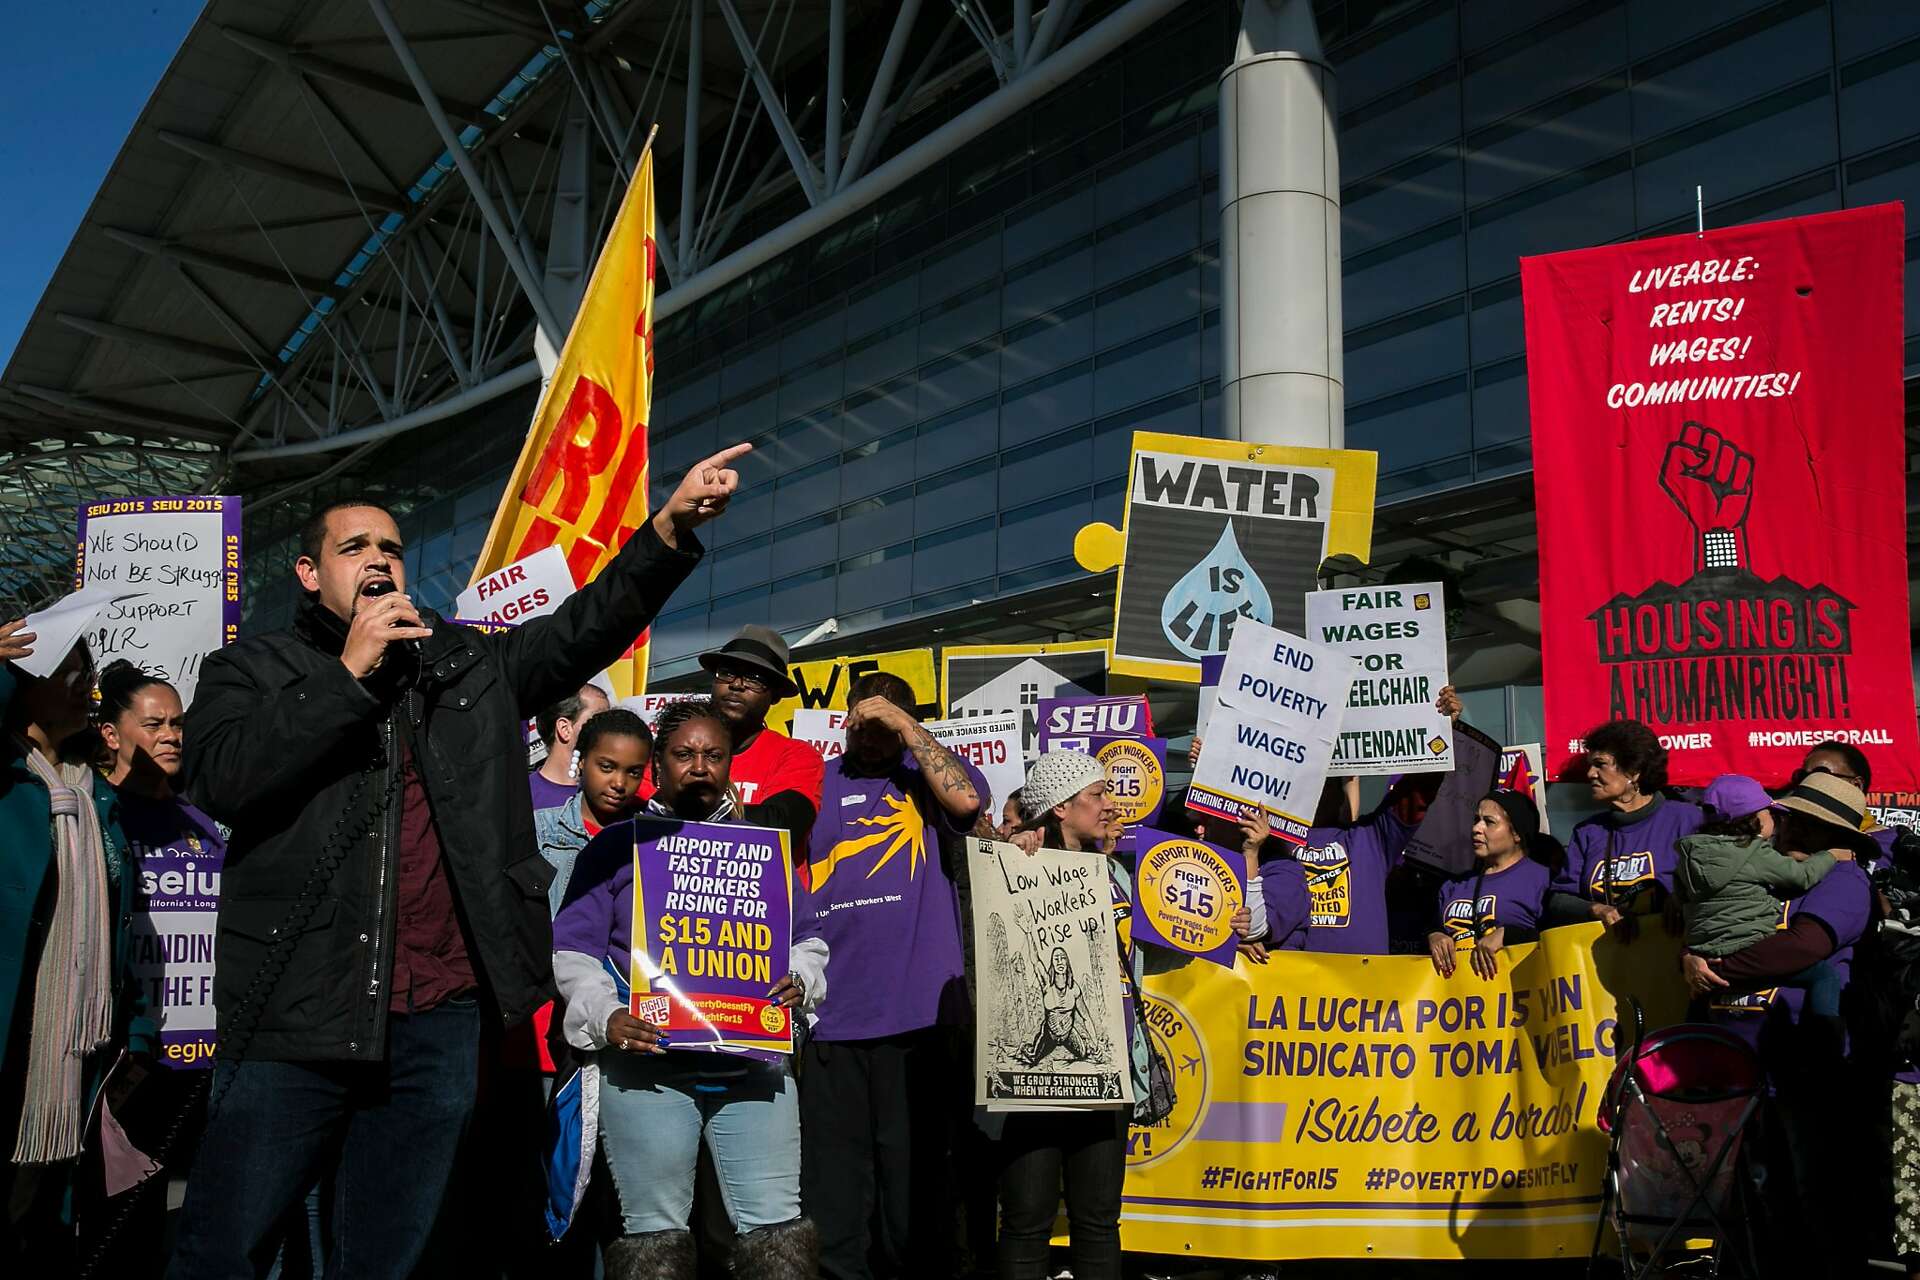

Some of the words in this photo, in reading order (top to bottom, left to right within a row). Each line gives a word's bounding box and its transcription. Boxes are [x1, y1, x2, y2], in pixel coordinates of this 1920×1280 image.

[1629, 256, 1760, 293] LIVEABLE:
[1649, 298, 1745, 328] RENTS!
[1649, 336, 1752, 367] WAGES!
[1606, 371, 1802, 409] COMMUNITIES!
[1140, 456, 1320, 519] WATER
[87, 503, 110, 517] SEIU
[113, 502, 145, 513] 2015
[152, 500, 183, 511] SEIU
[187, 500, 223, 511] 2015
[88, 529, 114, 554] WE
[227, 535, 239, 570] 2015
[128, 562, 152, 583] BE
[476, 564, 528, 602] FAIR
[1209, 566, 1244, 594] IS
[227, 571, 239, 602] SEIU
[1342, 590, 1403, 611] FAIR
[1322, 620, 1420, 643] WAGES
[1604, 600, 1797, 657] HOUSING
[1806, 599, 1843, 649] IS
[1273, 643, 1314, 673] END
[1238, 673, 1327, 720] POVERTY
[1345, 675, 1431, 708] EELCHAIR
[1609, 664, 1629, 723] A
[1632, 656, 1747, 725] HUMAN
[1748, 654, 1851, 722] RIGHT!
[956, 726, 987, 737] SERVICE
[989, 722, 1016, 733] UNITED
[1049, 704, 1138, 733] SEIU
[1237, 723, 1307, 764] WAGES
[1332, 727, 1428, 760] ATTENDANT
[1748, 729, 1894, 748] #HOMESFORALL
[947, 739, 1007, 766] CLEA
[1101, 745, 1122, 766] RPORT
[1124, 745, 1157, 774] WORKERS
[1112, 766, 1137, 774] FIGHT
[1230, 765, 1291, 800] NOW!
[1106, 778, 1141, 797] $15
[1119, 808, 1137, 818] LY!
[1190, 789, 1225, 811] FIGHTING
[1223, 799, 1239, 815] FOR
[1285, 820, 1309, 838] RIGHTS
[656, 836, 733, 859] AIRPORT
[735, 843, 773, 863] AND
[141, 862, 221, 896] seiu
[668, 855, 715, 876] FAST
[716, 859, 763, 880] FOOD
[1150, 846, 1190, 871] AIRPORT
[1192, 847, 1236, 893] WORKERS
[1175, 869, 1210, 887] FIGHT
[1308, 867, 1342, 886] JUSTICE
[673, 874, 761, 899] WORKERS
[1312, 886, 1346, 902] RKERS
[149, 899, 191, 908] lifornia's
[194, 900, 216, 909] Long
[665, 892, 728, 915] RISING
[733, 899, 768, 919] FOR
[830, 901, 854, 911] Service
[855, 896, 884, 907] Workers
[885, 894, 902, 903] West
[1165, 884, 1214, 918] $15
[659, 913, 712, 946] $15
[718, 920, 773, 951] AND
[1158, 910, 1183, 924] Poverty
[1184, 918, 1203, 931] wages
[1203, 922, 1218, 935] don't
[1312, 915, 1337, 925] SWW
[133, 934, 213, 964] TANDIN
[1171, 924, 1205, 947] FLY!
[659, 946, 678, 976] A
[687, 948, 771, 984] UNION
[150, 976, 193, 1007] THE
[640, 995, 666, 1014] FIGHT
[1248, 994, 1288, 1030] LA
[1298, 996, 1404, 1033] LUCHA
[1416, 995, 1486, 1034] POR
[1243, 1040, 1417, 1079] SINDICATO
[1429, 1038, 1523, 1078] TOMA
[1013, 1075, 1026, 1086] WE
[1027, 1075, 1052, 1086] GROW
[1053, 1076, 1098, 1087] STRONGER
[1013, 1086, 1037, 1096] WHEN
[1038, 1086, 1050, 1096] WE
[1050, 1086, 1074, 1096] FIGHT
[1075, 1086, 1100, 1097] BACK!
[1295, 1095, 1441, 1144] ¡Súbete
[1452, 1112, 1481, 1142] a
[1490, 1081, 1588, 1141] bordo!
